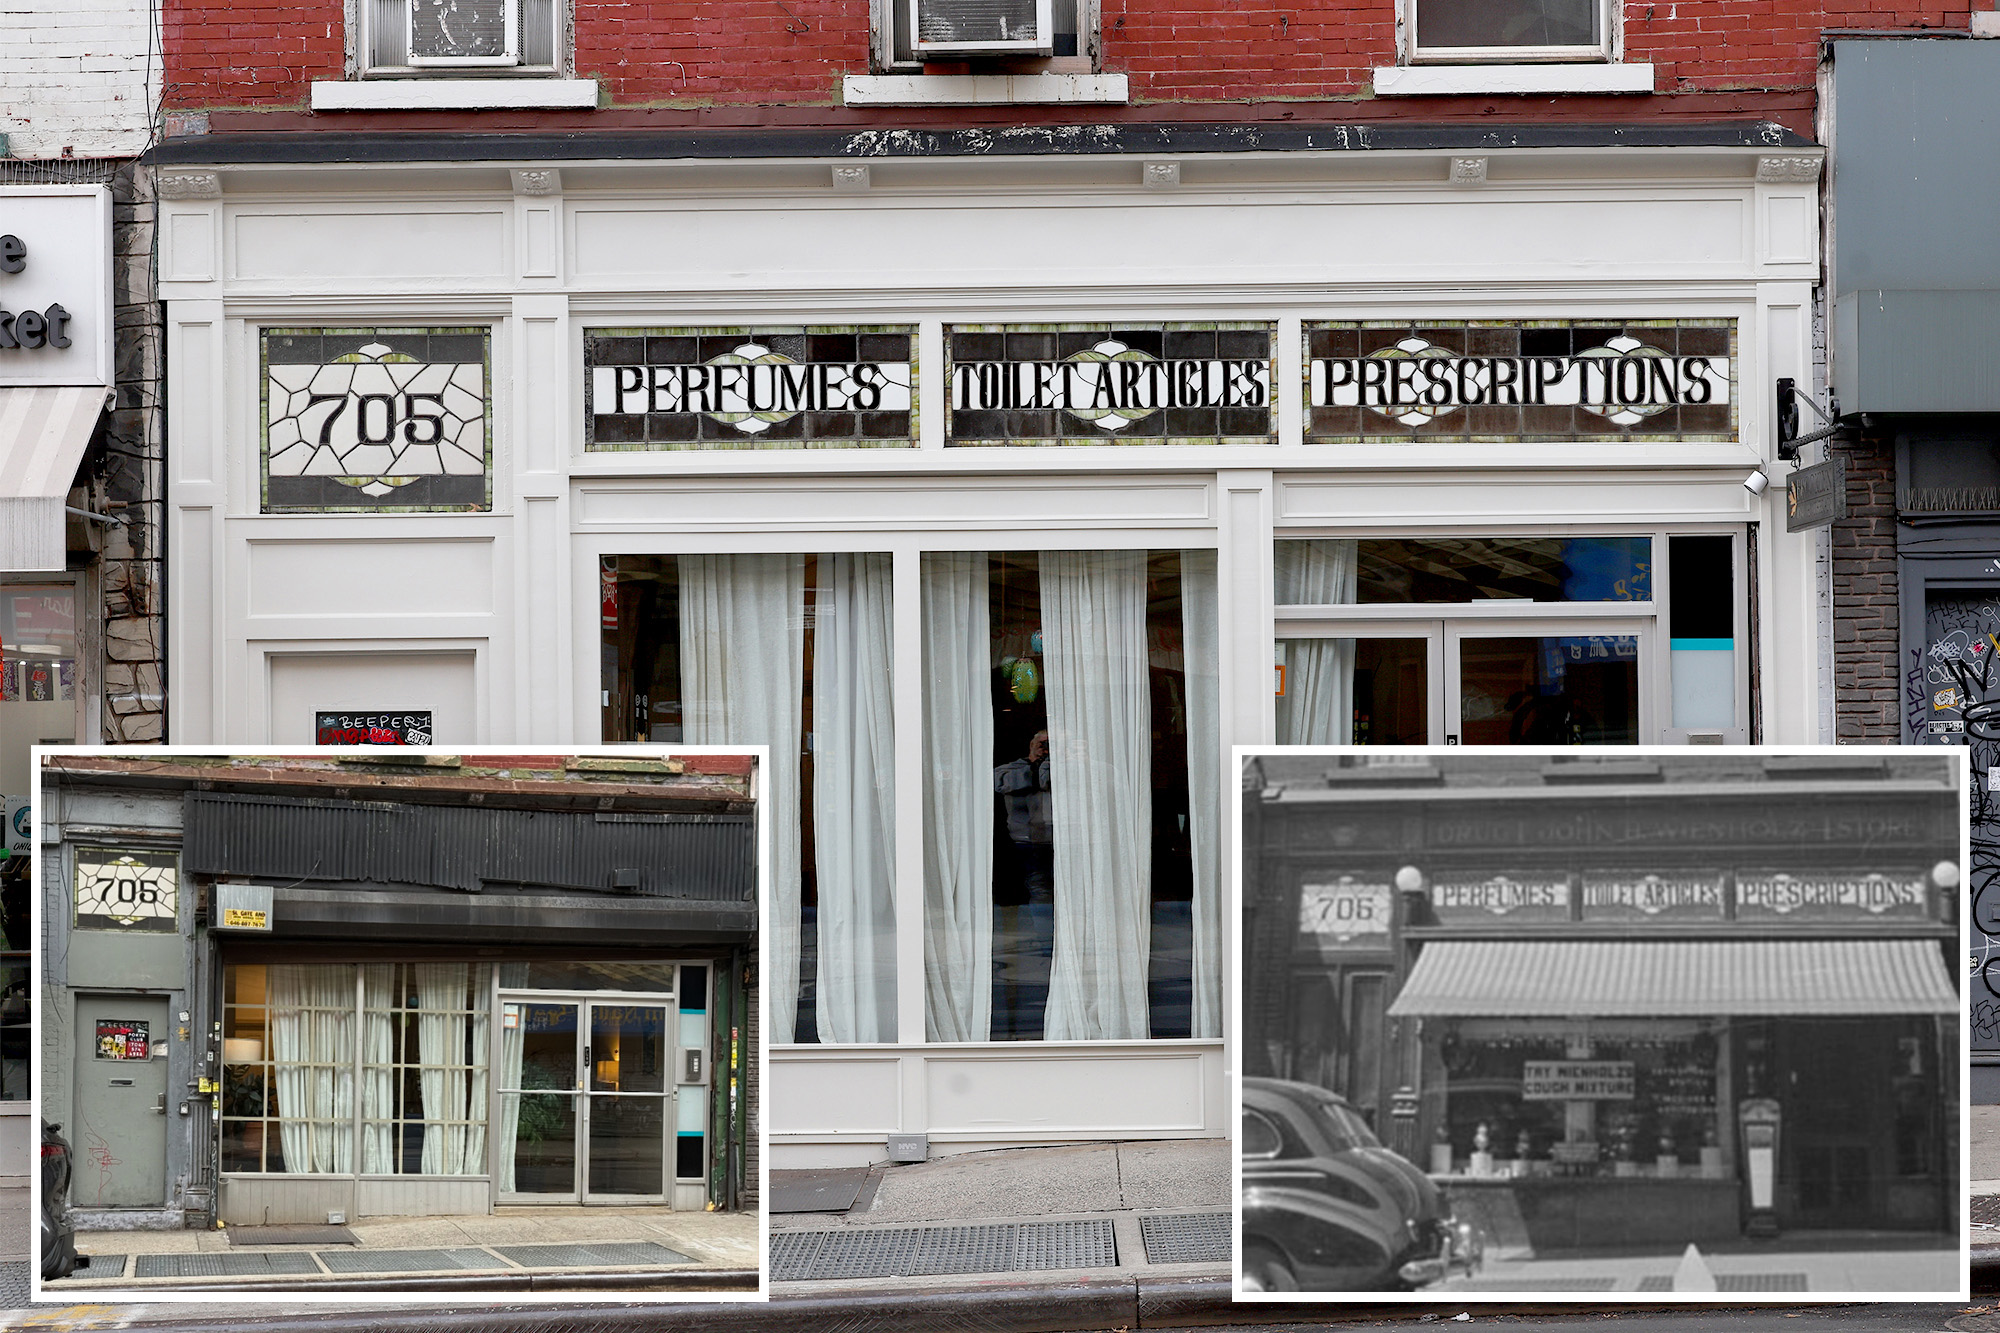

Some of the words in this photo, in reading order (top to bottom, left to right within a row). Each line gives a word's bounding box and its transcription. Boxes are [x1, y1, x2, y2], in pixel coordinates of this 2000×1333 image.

[613, 363, 881, 412] PERFUMES
[952, 361, 1079, 409] TOILET
[1091, 360, 1267, 409] ARTICLES
[1323, 357, 1713, 405] PRESCRIPTIONS
[307, 393, 442, 445] 705
[96, 877, 158, 903] 705
[1445, 884, 1554, 905] PERFUMES
[1743, 881, 1917, 903] PRESCRIPTIONS
[1524, 1082, 1570, 1094] COUGH
[1575, 1081, 1634, 1094] MIXTURE
